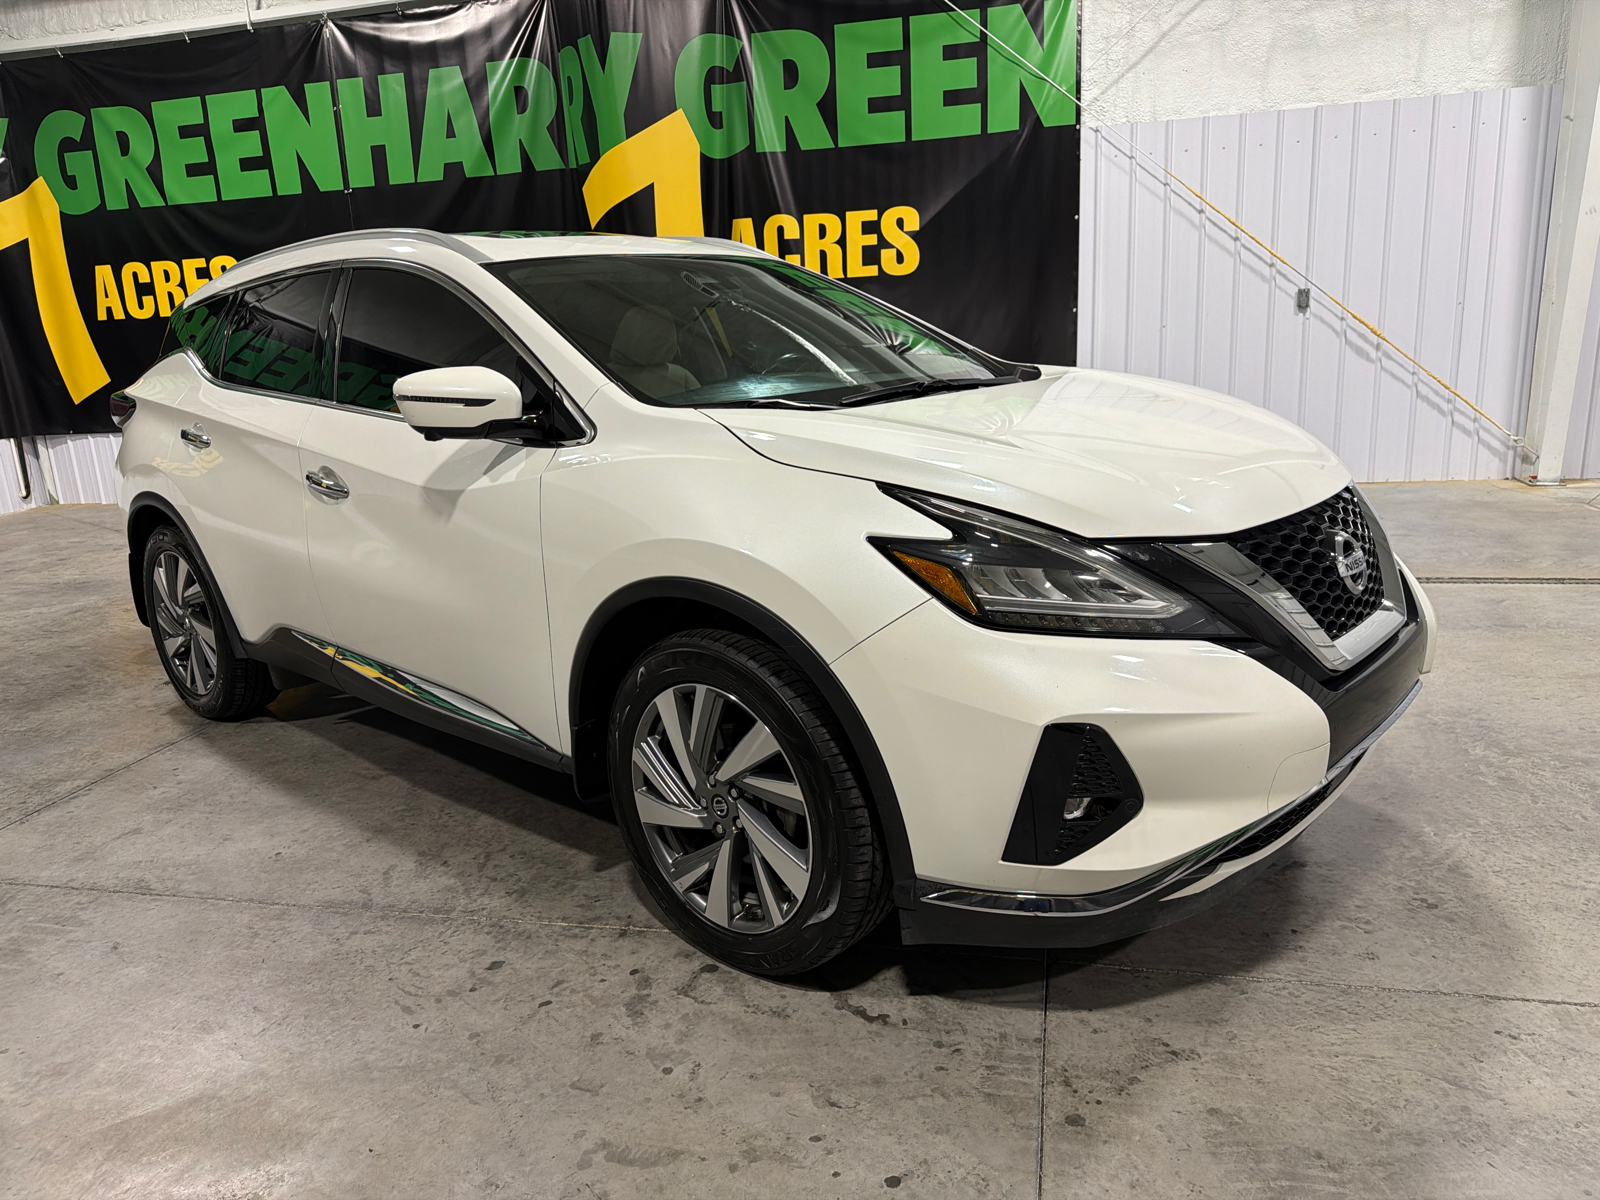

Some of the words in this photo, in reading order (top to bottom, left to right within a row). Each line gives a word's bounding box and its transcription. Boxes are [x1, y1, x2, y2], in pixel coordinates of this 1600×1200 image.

[33, 81, 345, 215] GREEN
[336, 32, 642, 190] HARRY
[674, 0, 1078, 160] GREEN
